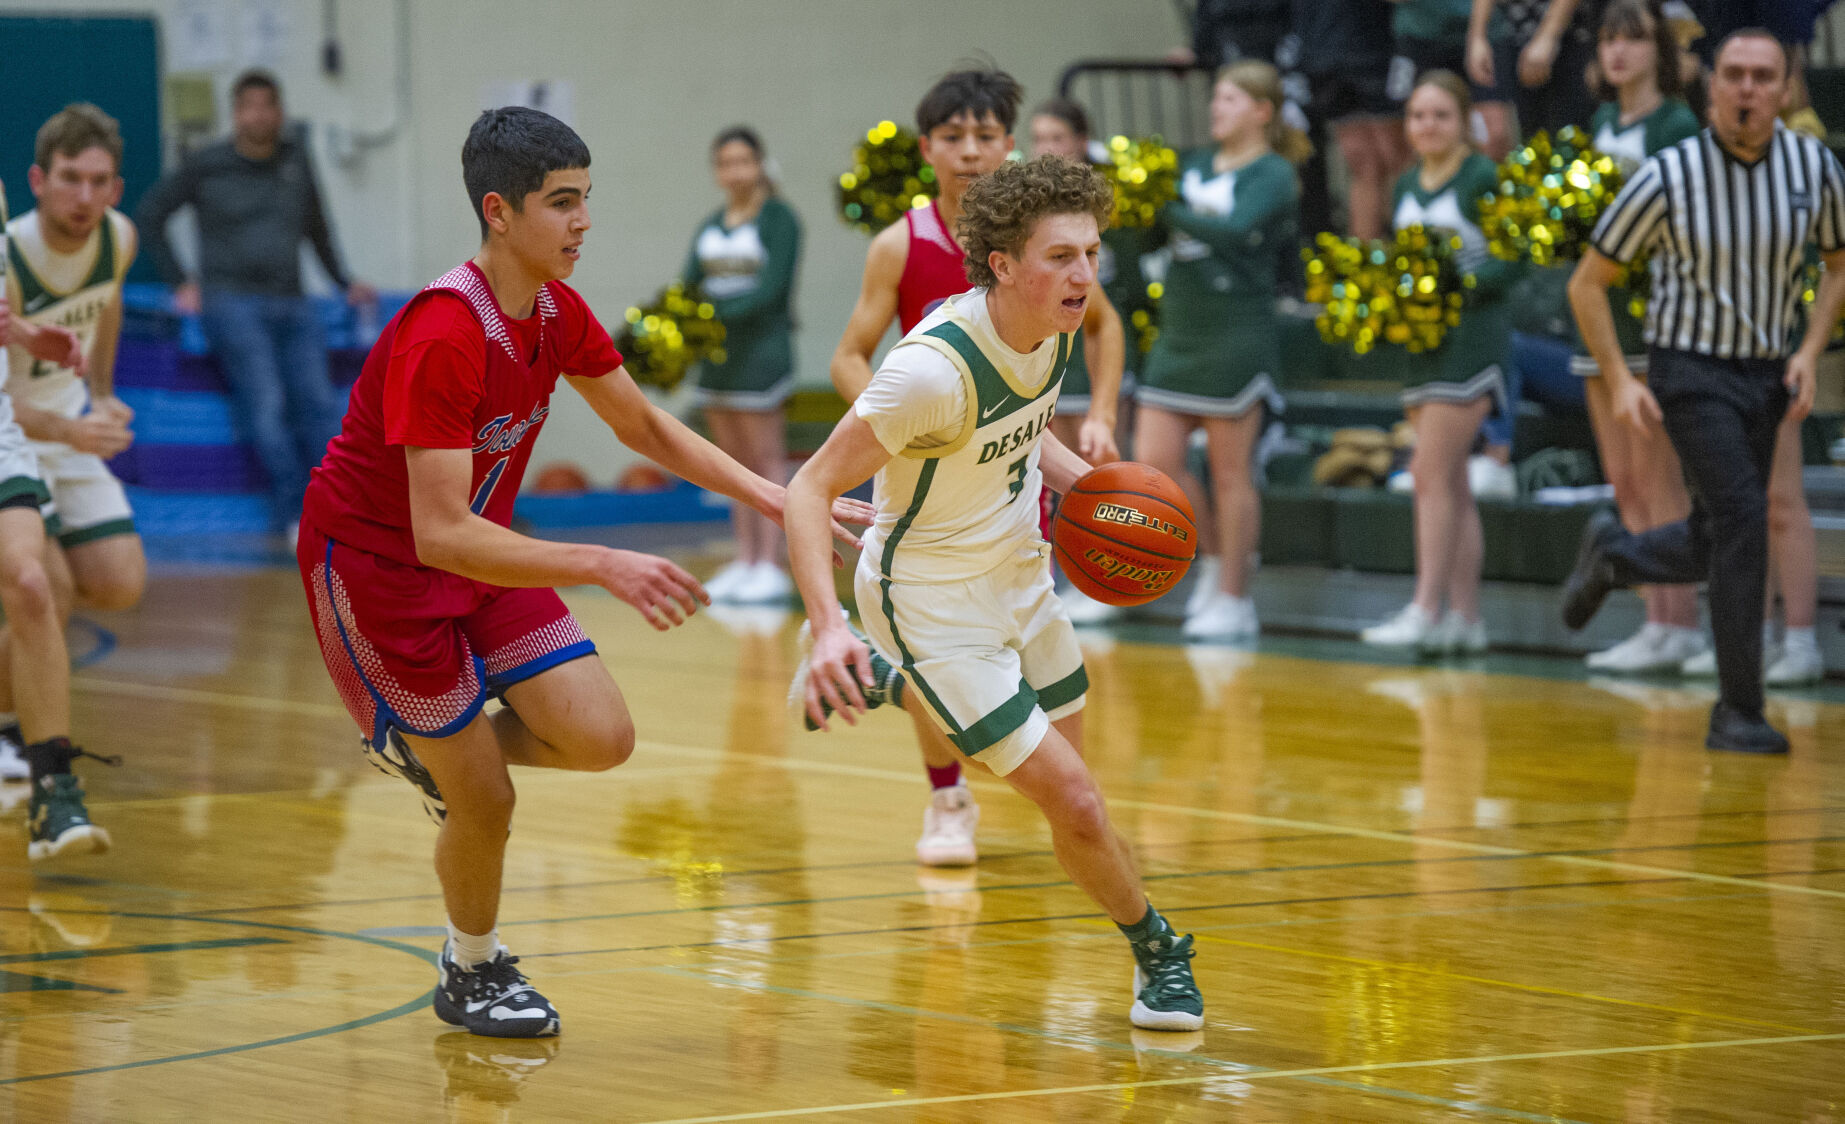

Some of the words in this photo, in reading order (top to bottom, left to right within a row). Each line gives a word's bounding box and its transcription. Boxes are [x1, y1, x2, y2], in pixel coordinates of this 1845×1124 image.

[469, 456, 510, 516] 1
[1007, 453, 1029, 505] 3
[1083, 547, 1177, 590] Baden
